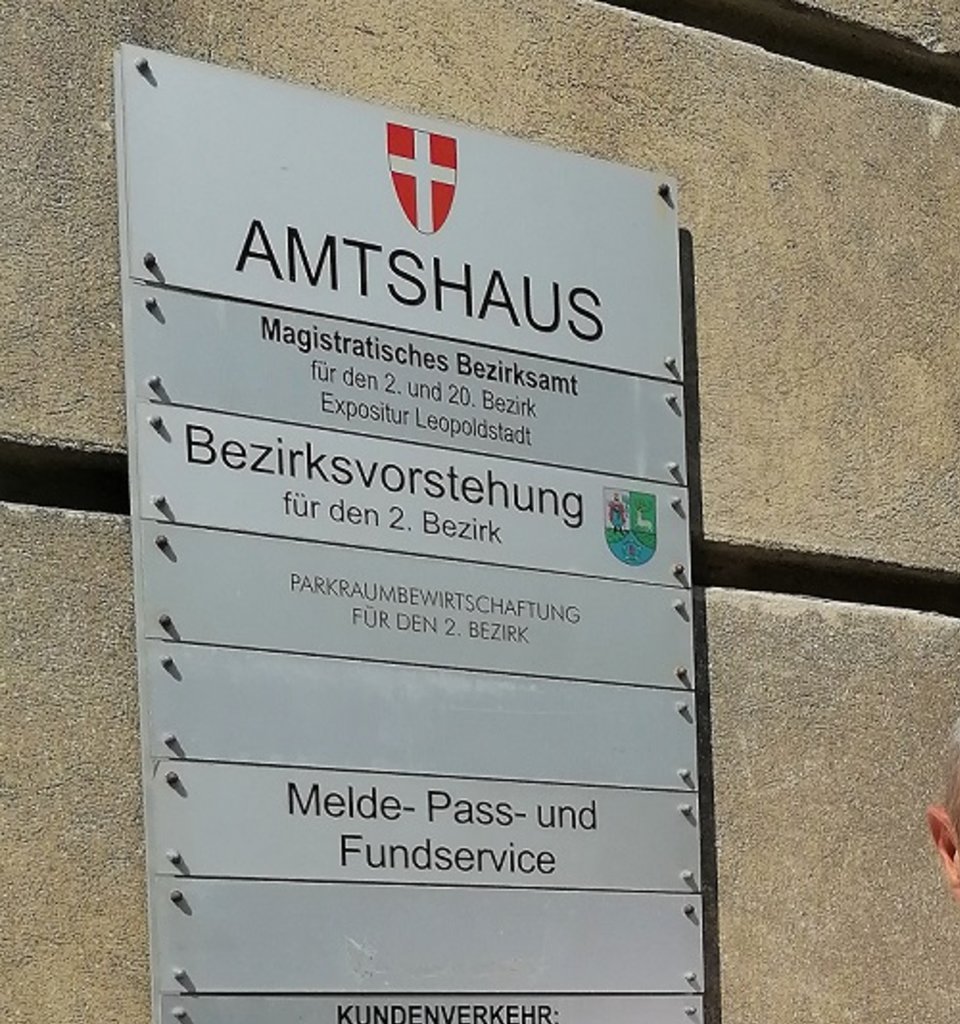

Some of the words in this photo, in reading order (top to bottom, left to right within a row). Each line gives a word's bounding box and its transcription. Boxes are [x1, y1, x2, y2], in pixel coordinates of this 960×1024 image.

[235, 219, 604, 342] AMTSHAUS
[260, 316, 449, 372] Magistratisches
[456, 351, 579, 396] Bezirksamt
[311, 360, 336, 383] für
[342, 365, 379, 389] den
[384, 374, 402, 396] 2.
[408, 376, 442, 400] und
[448, 384, 477, 407] 20.
[482, 389, 537, 418] Bezirk
[320, 392, 410, 426] Expositur
[415, 407, 532, 446] Leopoldstadt
[185, 424, 584, 528] Bezirksvorstehung
[283, 492, 321, 519] für
[329, 497, 380, 528] den
[388, 506, 412, 533] 2.
[423, 510, 503, 545] Bezirk
[290, 573, 581, 624] PARKRAUMBEWIRTSCHAFTUNG
[352, 605, 390, 629] FÜR
[397, 613, 438, 634] DEN
[444, 618, 461, 637] 2.
[469, 621, 530, 644] BEZIRK
[287, 782, 415, 820] Melde-
[427, 791, 527, 827] Pass-
[537, 800, 598, 830] und
[340, 834, 556, 874] Fundservice
